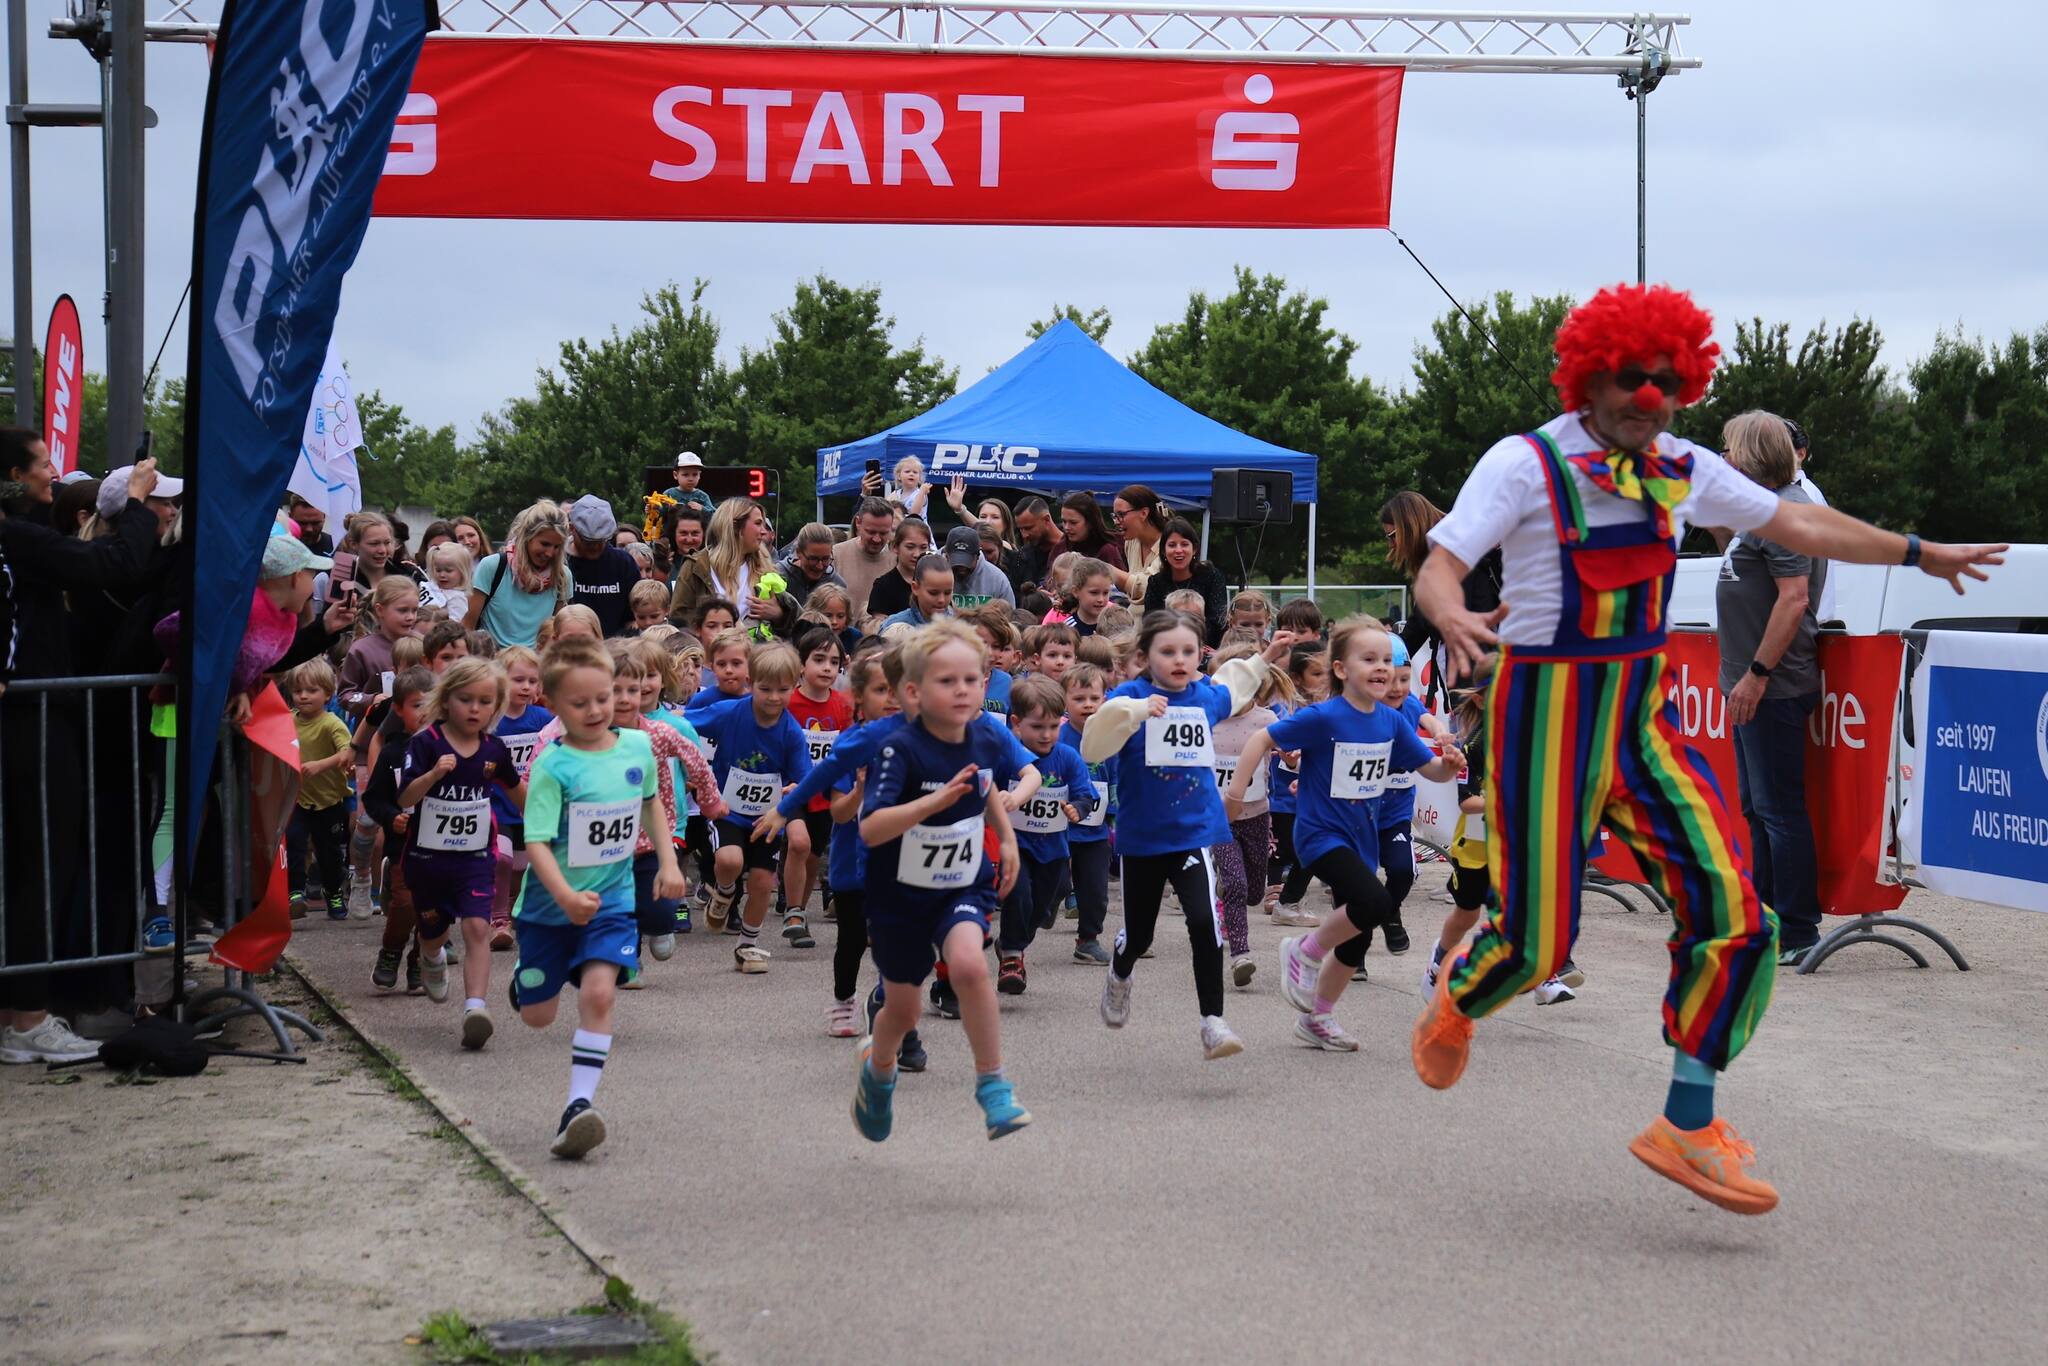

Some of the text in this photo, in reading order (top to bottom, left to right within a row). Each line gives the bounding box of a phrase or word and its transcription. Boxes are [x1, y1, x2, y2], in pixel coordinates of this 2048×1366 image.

[649, 85, 1025, 188] START
[750, 469, 765, 498] 3
[928, 469, 975, 478] POTSDAMER
[977, 472, 1017, 480] LAUFCLUB
[575, 581, 621, 594] hummel
[1163, 723, 1205, 748] 498
[1936, 722, 1997, 752] seit 1997
[1349, 757, 1386, 782] 475
[1958, 764, 2012, 798] LAUFEN
[736, 784, 773, 803] 452
[1019, 799, 1059, 819] 463
[435, 814, 478, 836] 795
[588, 815, 634, 846] 845
[1971, 809, 2001, 840] AUS
[922, 838, 973, 869] 774
